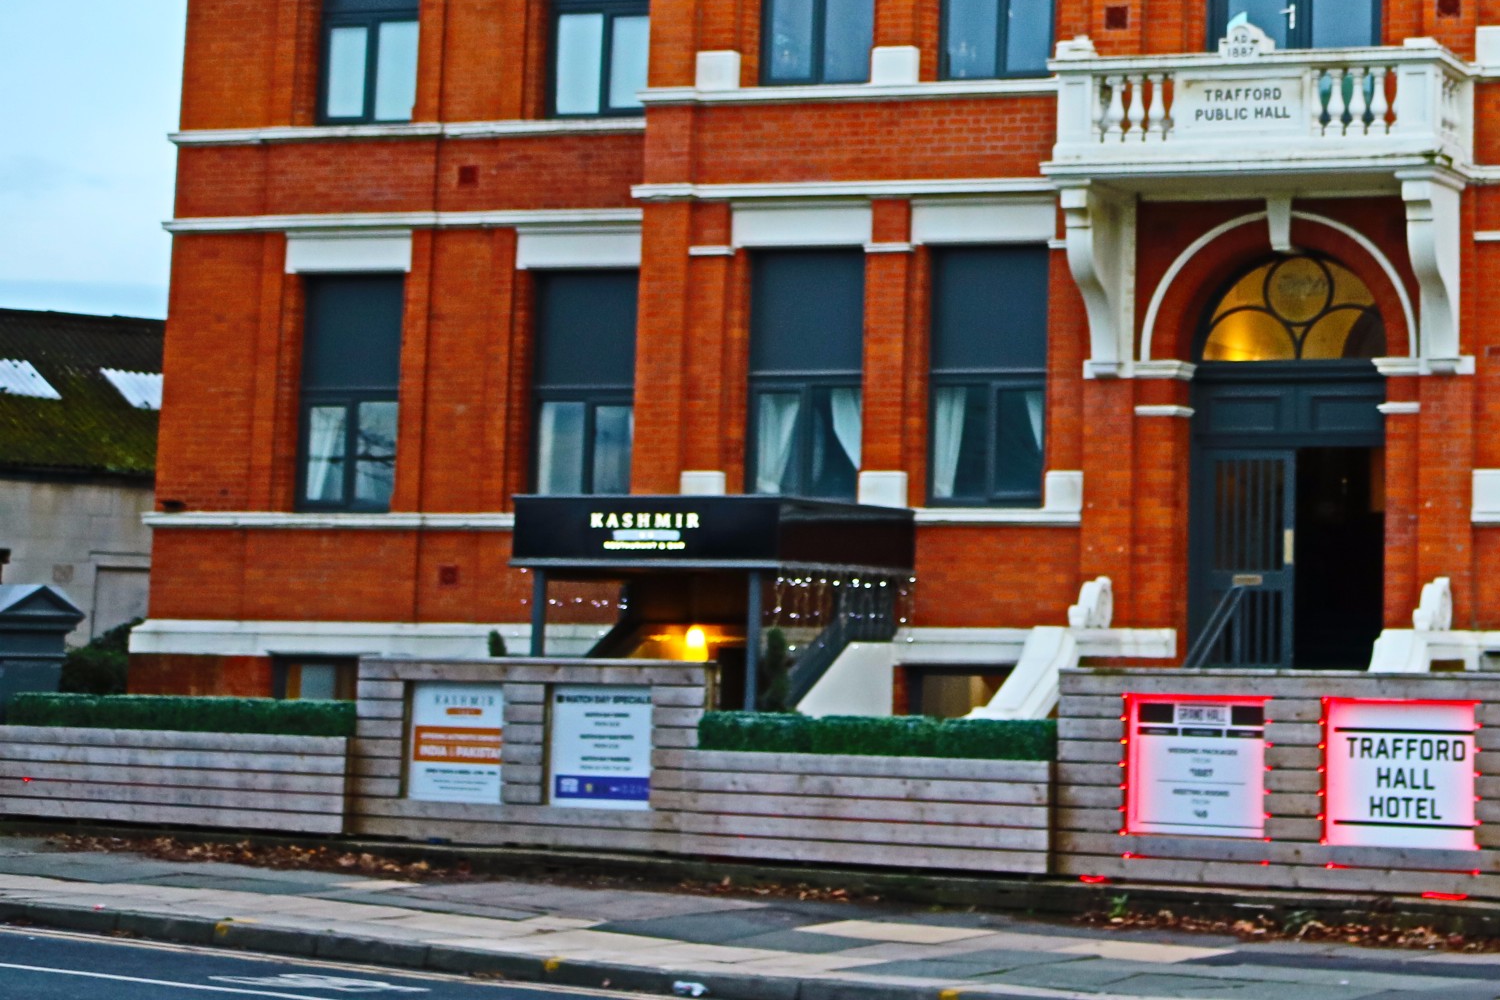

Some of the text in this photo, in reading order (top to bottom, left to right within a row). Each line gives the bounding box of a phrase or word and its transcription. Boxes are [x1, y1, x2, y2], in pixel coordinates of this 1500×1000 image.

[1226, 46, 1254, 58] 1887
[1204, 87, 1282, 101] TRAFFORD
[1195, 106, 1291, 121] PUBLIC HALL
[590, 512, 700, 529] KASHMIR
[435, 694, 495, 706] KASHMIR
[1206, 709, 1226, 721] HALL
[1346, 737, 1466, 762] TRAFFORD
[1376, 767, 1436, 790] HALL
[1369, 796, 1442, 820] HOTEL
